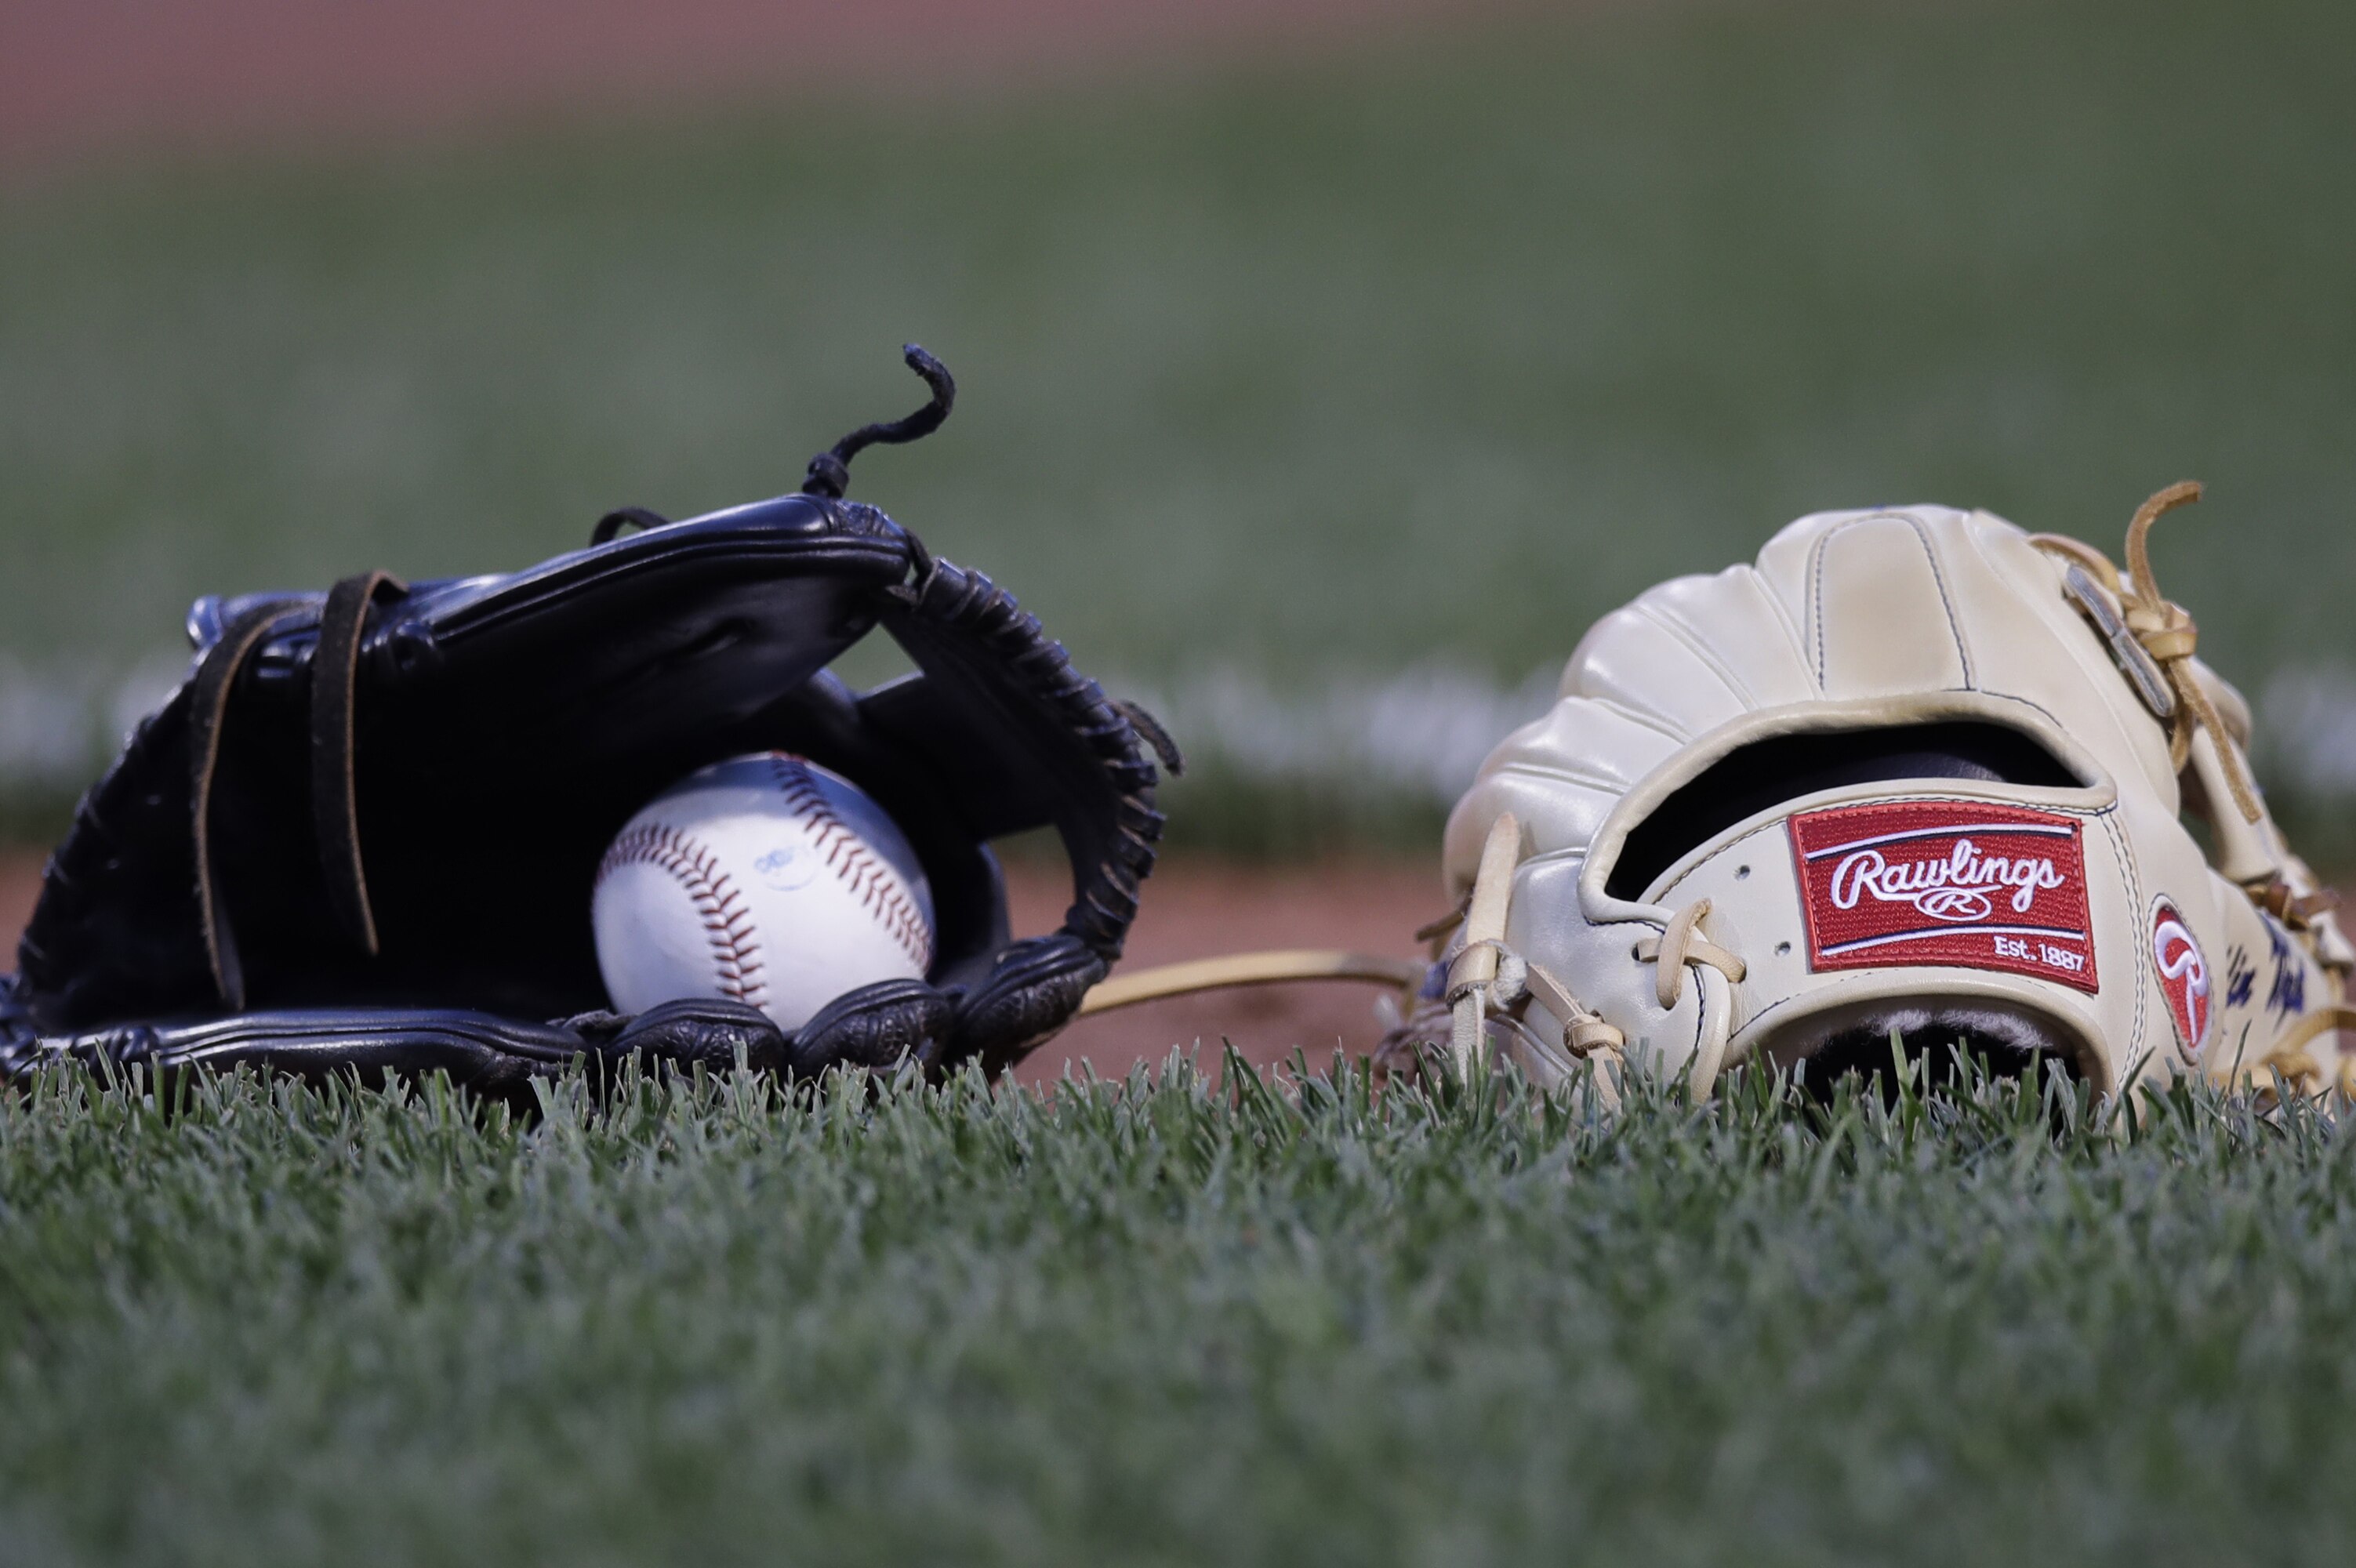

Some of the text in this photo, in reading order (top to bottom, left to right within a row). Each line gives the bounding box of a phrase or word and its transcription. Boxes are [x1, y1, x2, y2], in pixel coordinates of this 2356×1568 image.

[1831, 839, 2064, 910] Rawlings
[1994, 935, 2086, 971] Est. 1887
